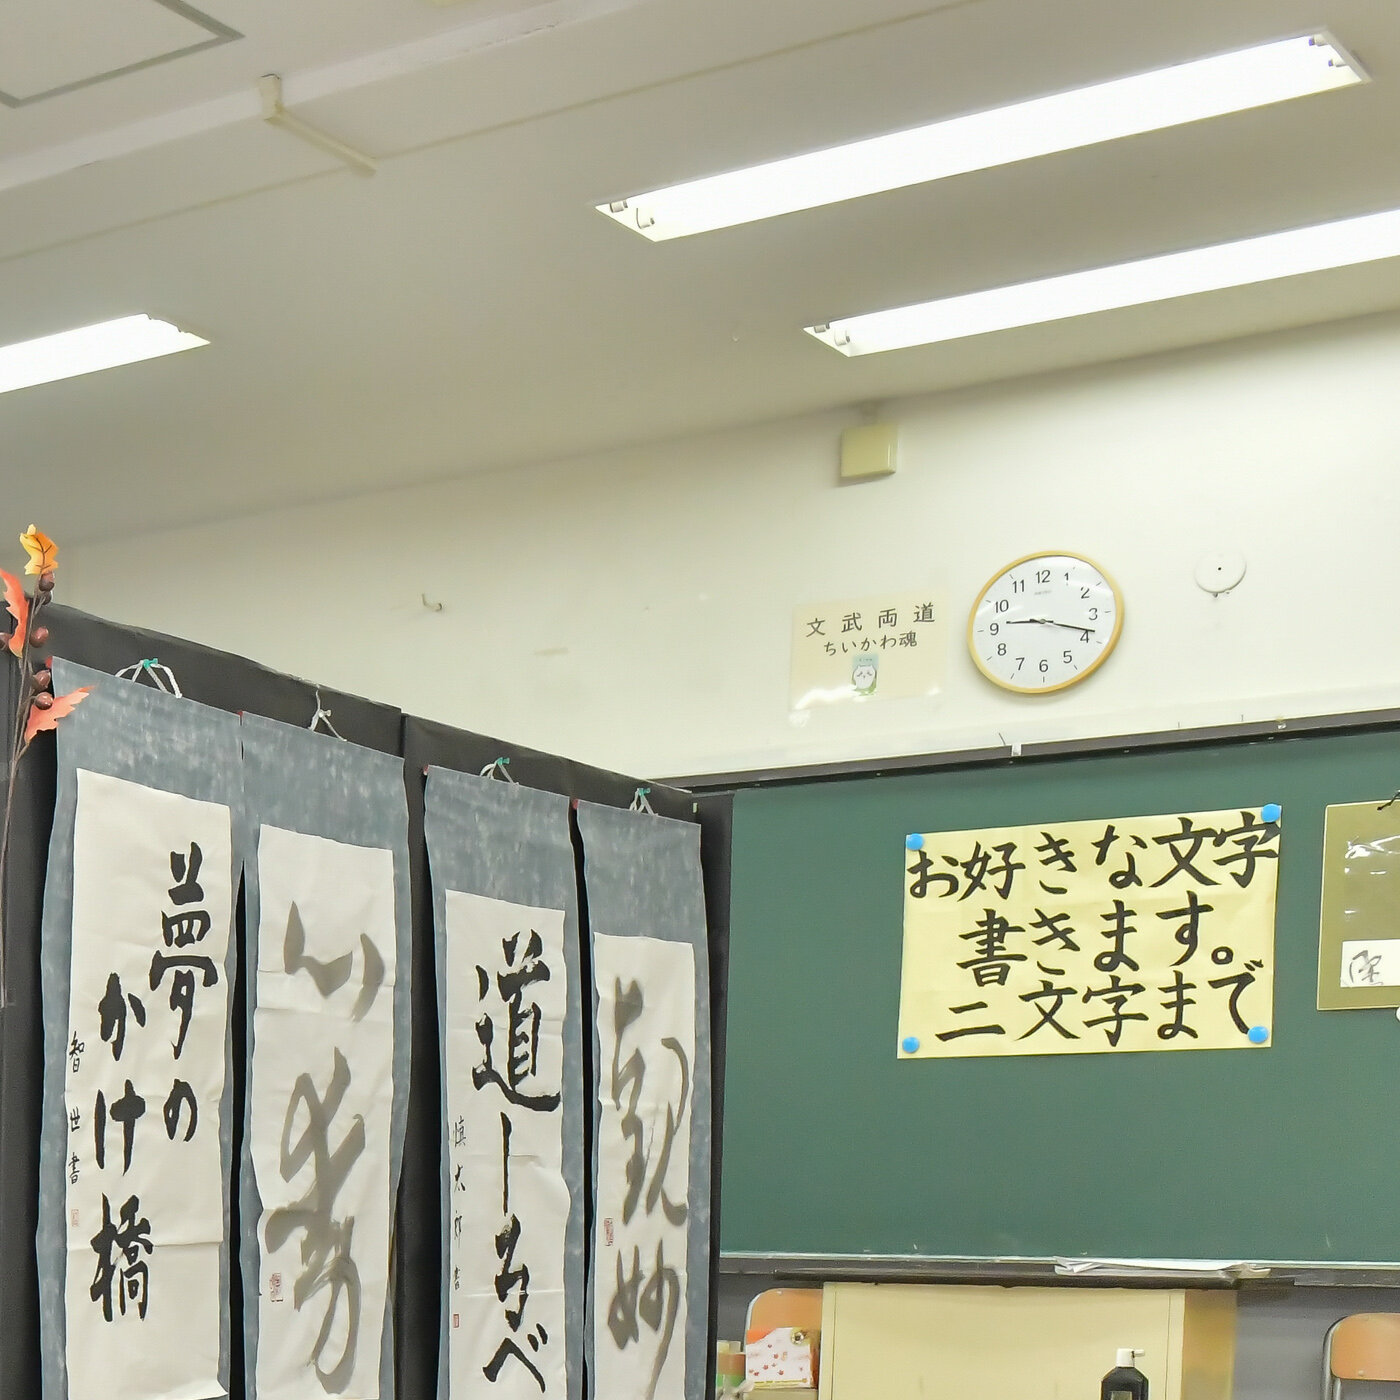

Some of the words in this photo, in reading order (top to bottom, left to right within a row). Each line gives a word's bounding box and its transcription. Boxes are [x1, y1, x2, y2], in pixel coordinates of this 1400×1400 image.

[1036, 569, 1051, 584] 12
[1012, 579, 1025, 593] 11
[1080, 586, 1090, 599] 2
[995, 599, 1009, 613] 10
[1088, 608, 1098, 621] 3
[989, 622, 999, 636] 9
[1080, 629, 1090, 643] 4
[823, 630, 918, 656] ちいかわ魂
[997, 643, 1007, 656] 8
[1015, 657, 1025, 671] 7
[1063, 650, 1073, 664] 5
[1038, 659, 1049, 673] 6
[907, 811, 1280, 902] お好きな文字
[956, 889, 1234, 988] 書きます。
[935, 958, 1265, 1047] 二文字まで
[471, 929, 563, 1394] 道しるべ
